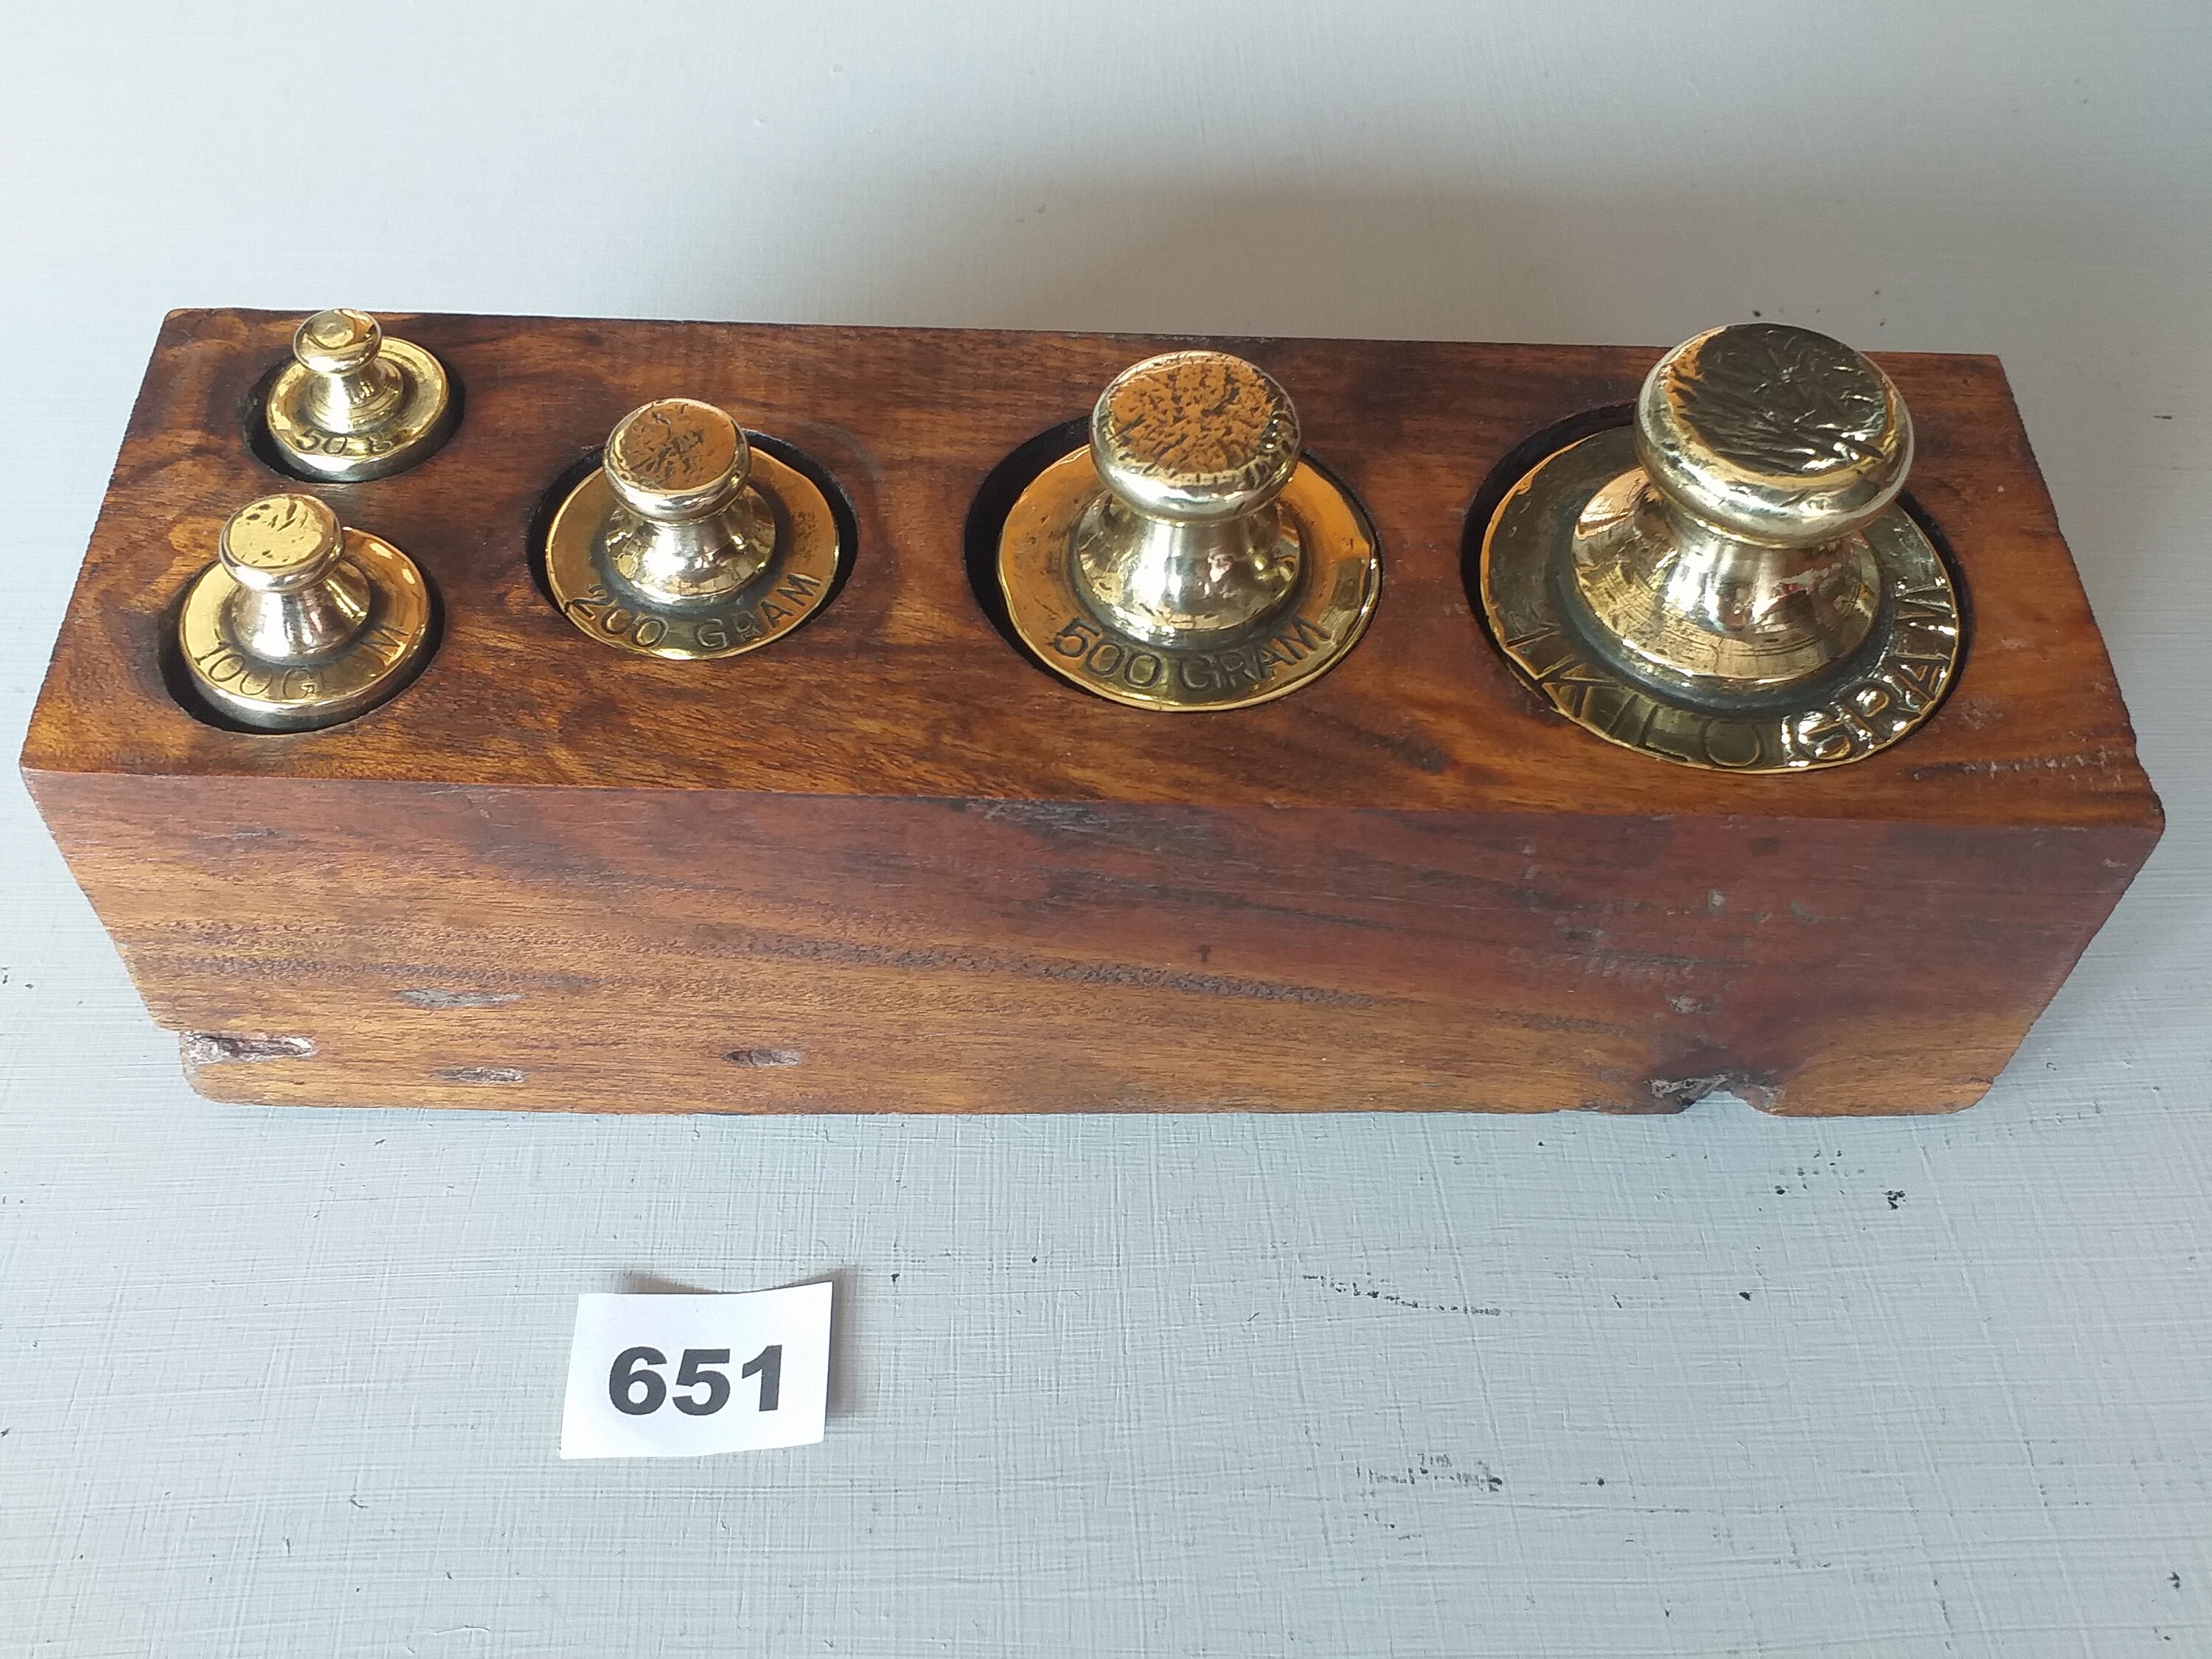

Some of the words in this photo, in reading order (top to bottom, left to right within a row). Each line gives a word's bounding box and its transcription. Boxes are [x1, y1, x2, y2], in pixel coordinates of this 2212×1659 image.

[295, 429, 347, 454] 50
[563, 583, 669, 649] 200
[695, 573, 822, 650] GRAM
[194, 627, 274, 696] 100
[1046, 617, 1163, 689] 500
[1180, 616, 1329, 692] GRAM
[609, 1345, 782, 1416] 651
